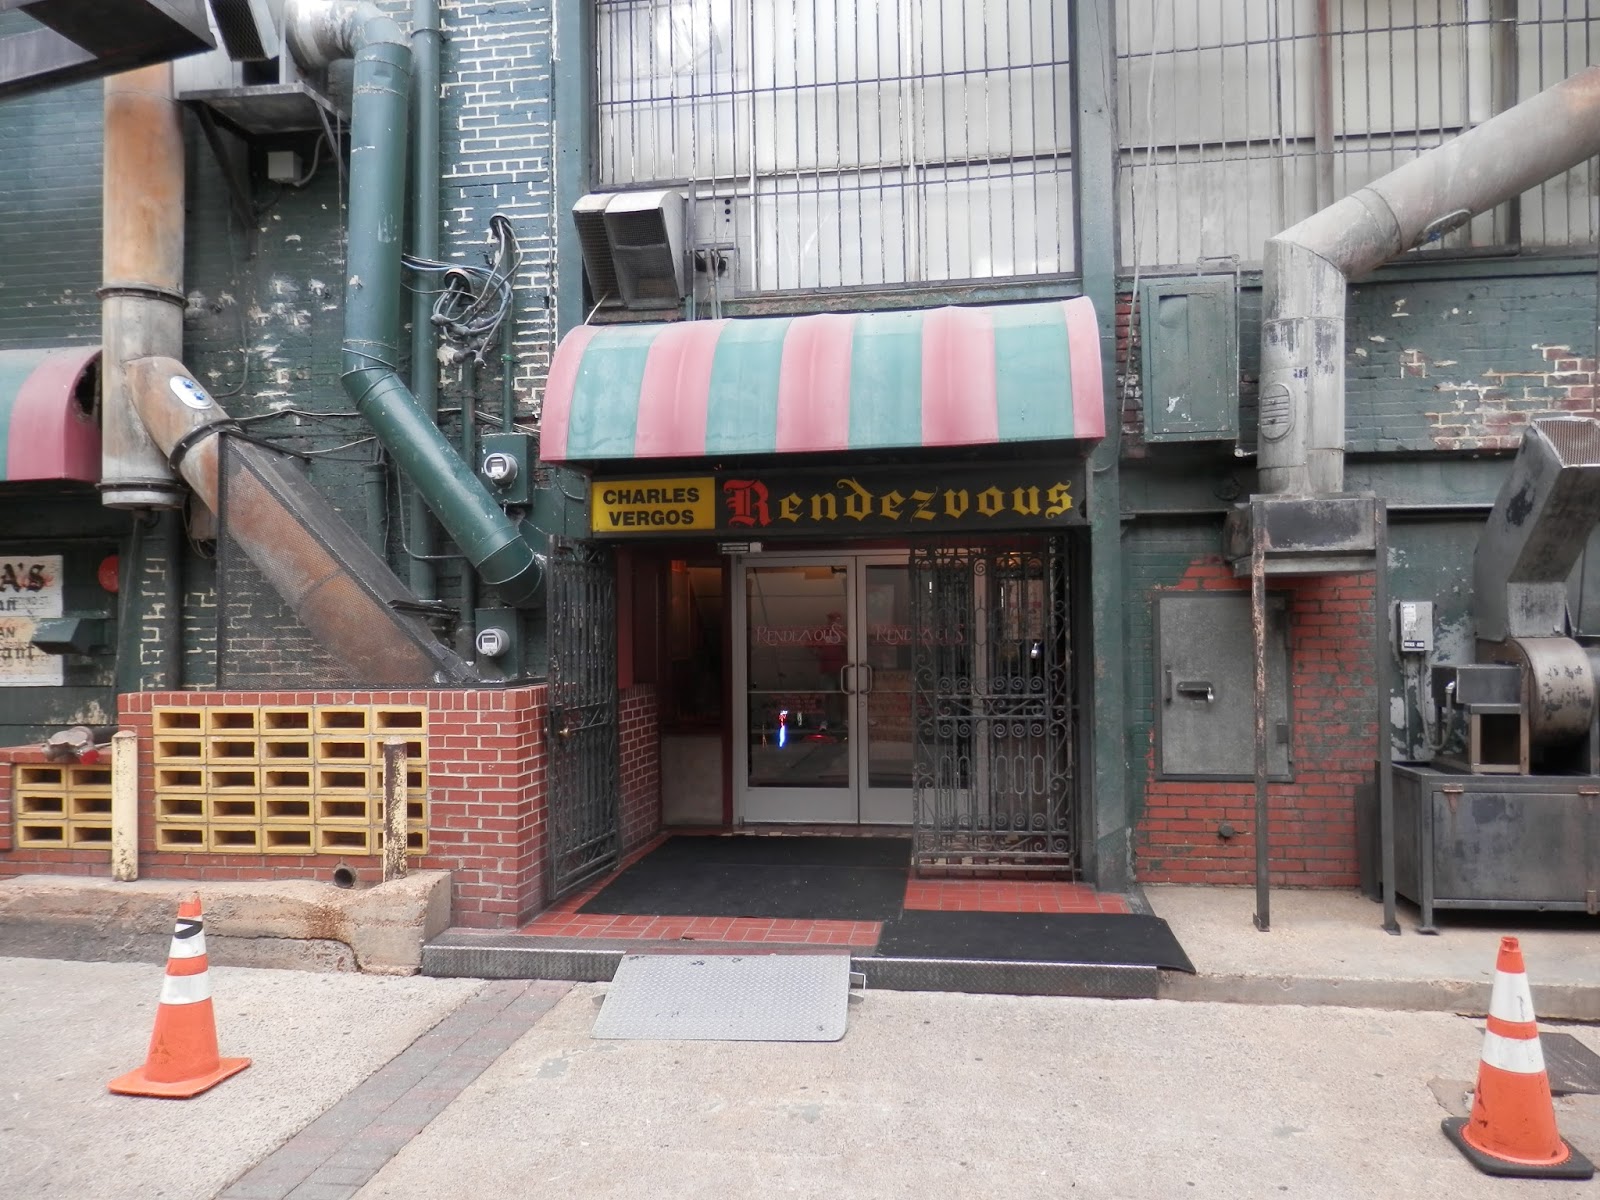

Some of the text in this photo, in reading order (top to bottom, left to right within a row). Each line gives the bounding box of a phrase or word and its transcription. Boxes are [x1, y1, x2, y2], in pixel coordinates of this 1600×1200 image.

[602, 487, 700, 505] CHARLES
[723, 477, 1074, 528] Rendezvous
[609, 509, 695, 527] VERGOS
